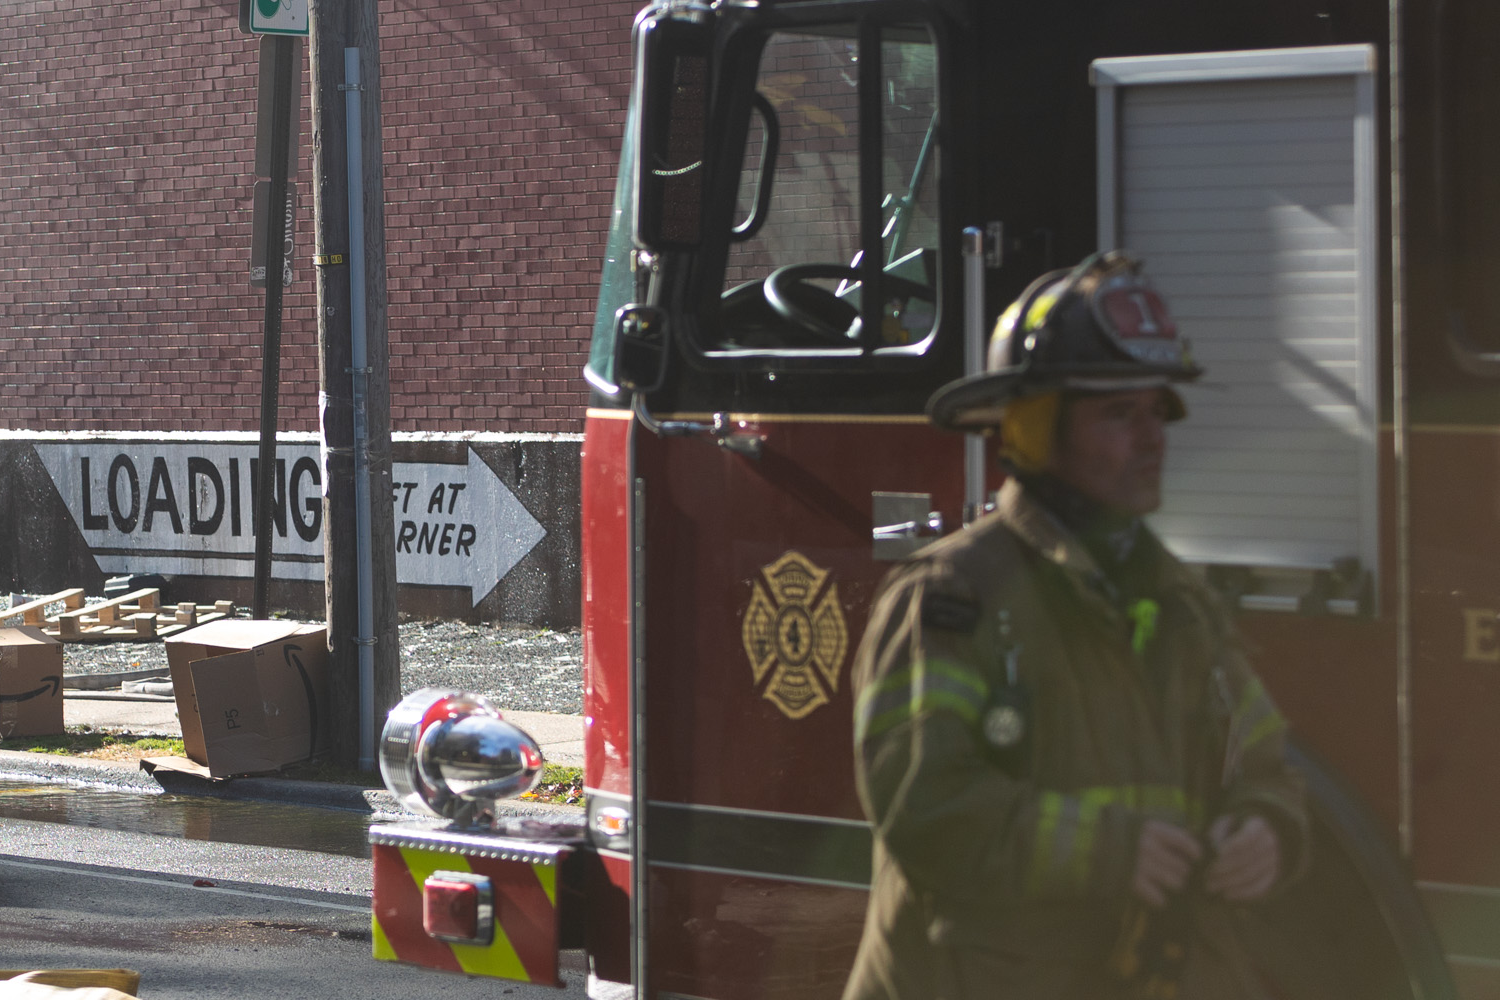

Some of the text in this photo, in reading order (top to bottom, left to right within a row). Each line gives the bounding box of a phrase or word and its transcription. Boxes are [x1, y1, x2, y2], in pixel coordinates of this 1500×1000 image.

[1130, 293, 1158, 333] 1
[81, 453, 322, 542] LOADING
[428, 483, 467, 516] AT
[1463, 607, 1500, 661] E
[224, 708, 241, 731] P5
